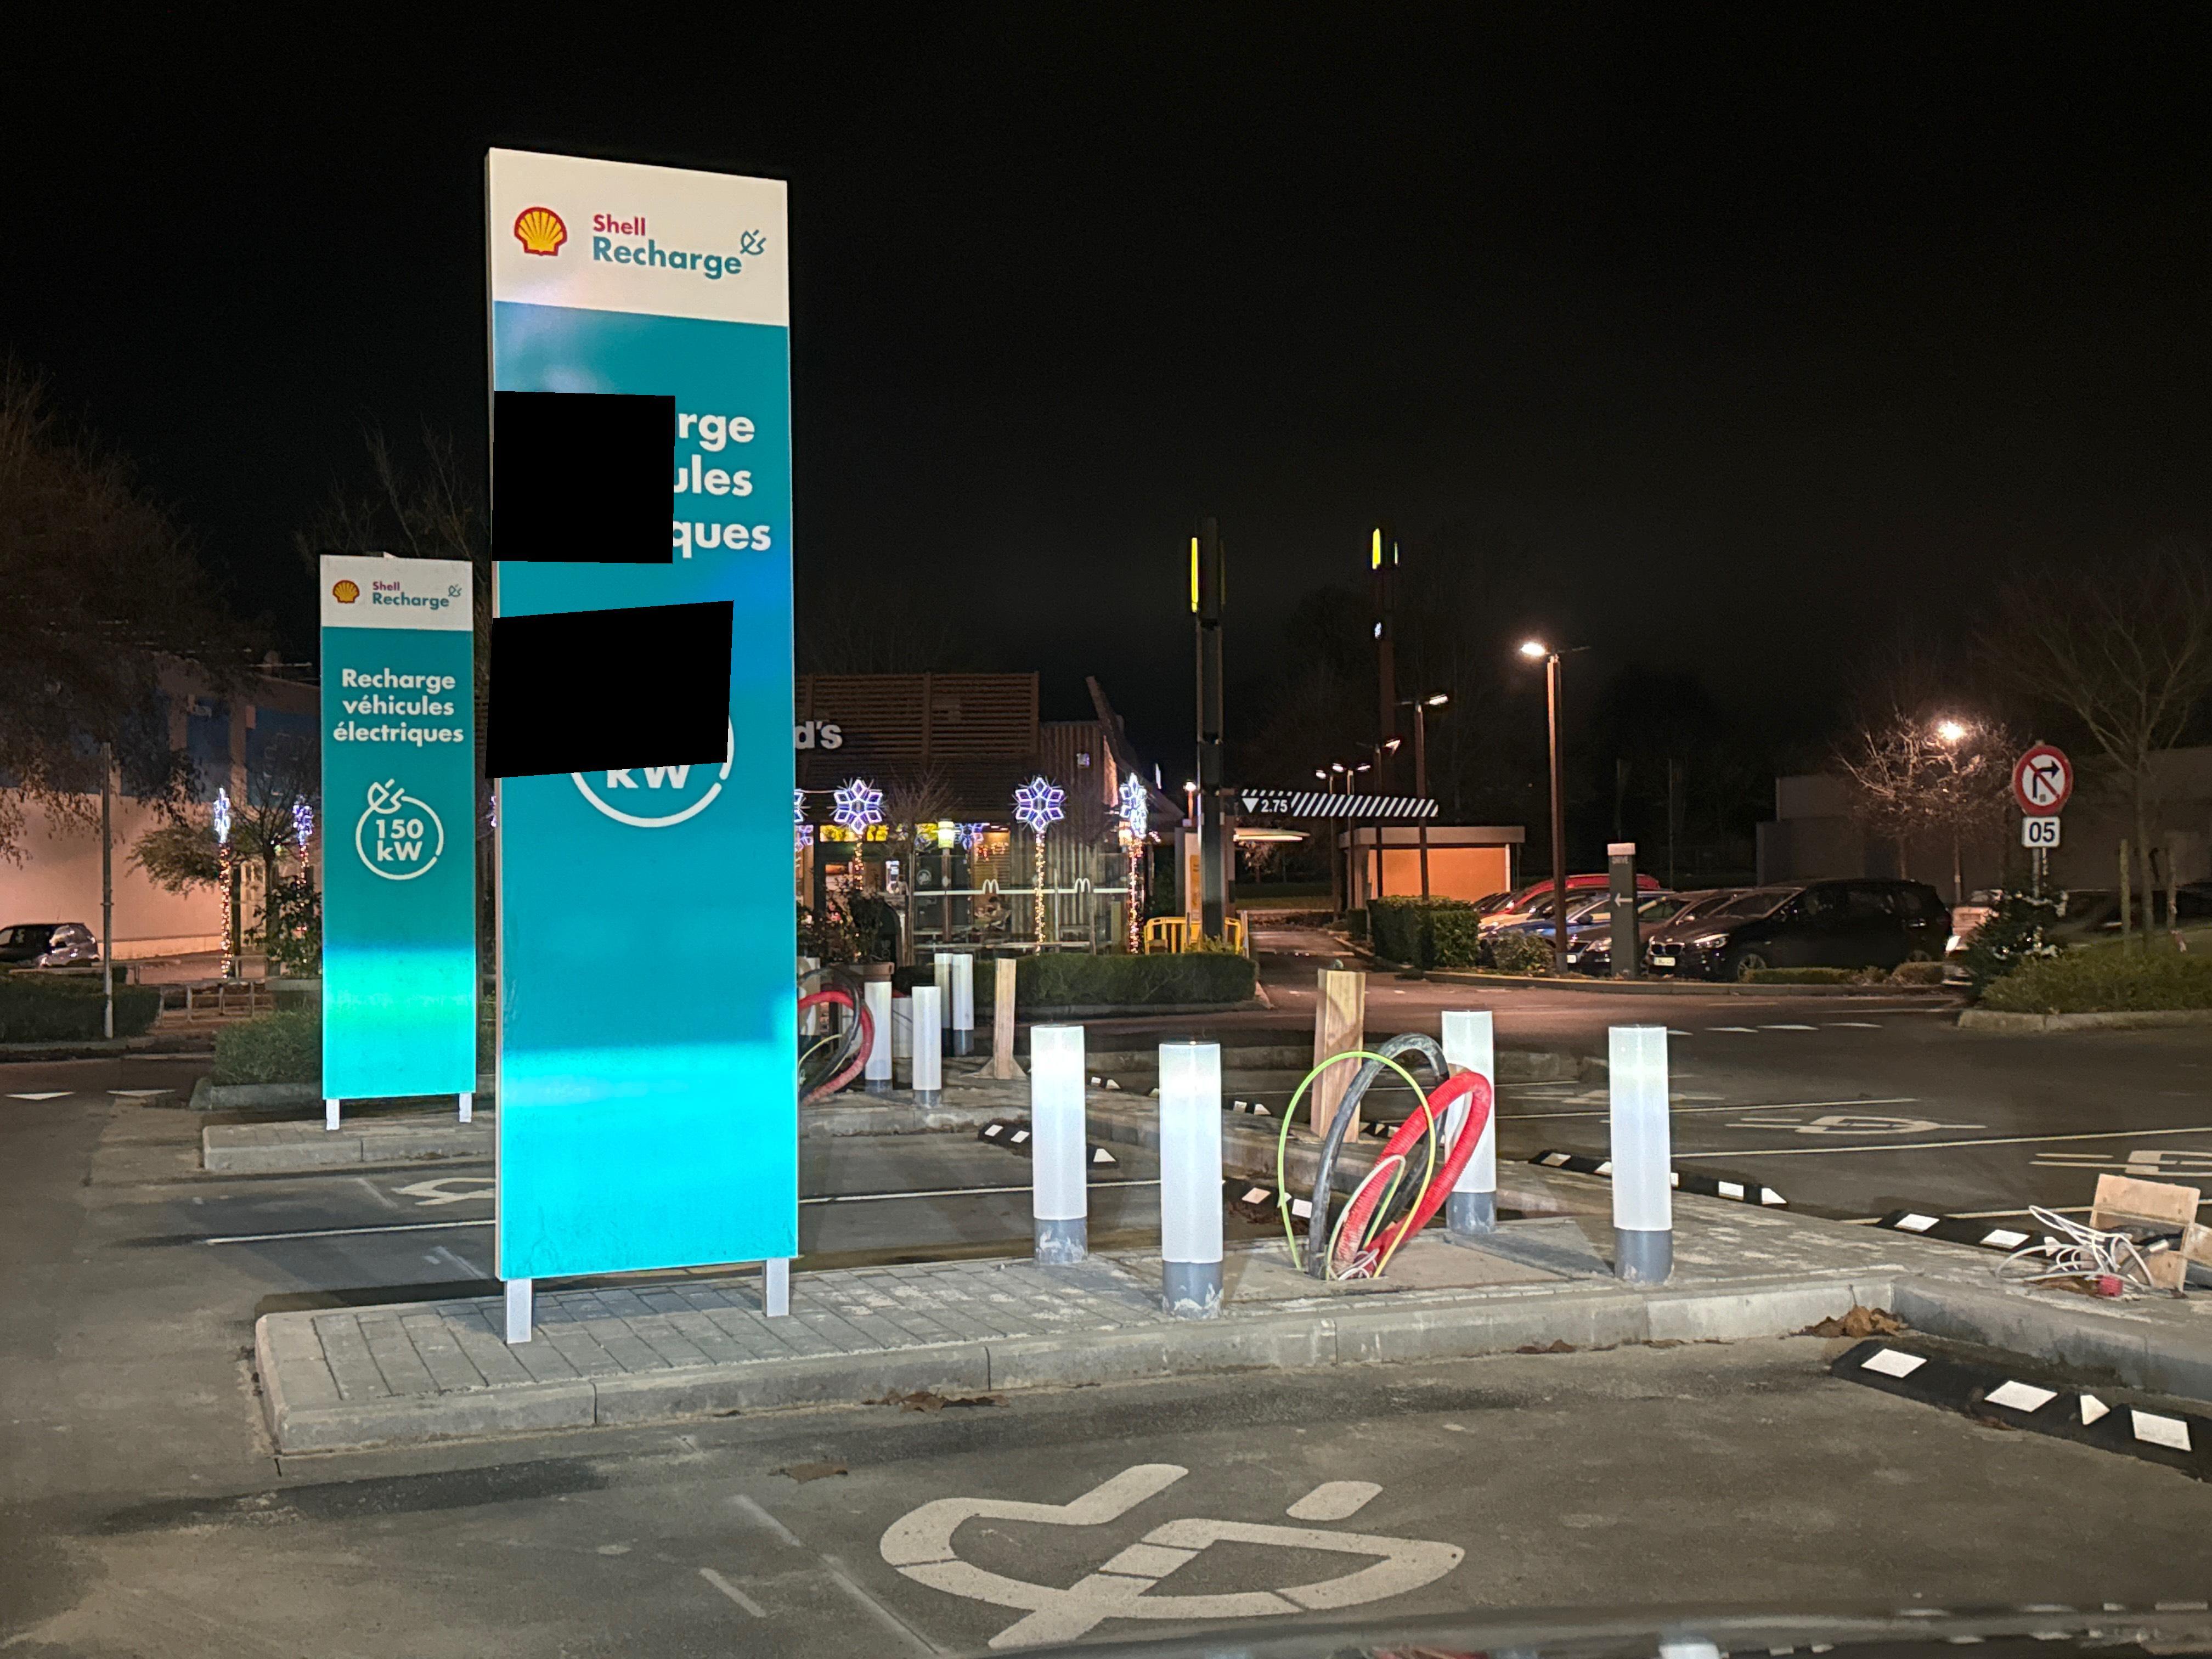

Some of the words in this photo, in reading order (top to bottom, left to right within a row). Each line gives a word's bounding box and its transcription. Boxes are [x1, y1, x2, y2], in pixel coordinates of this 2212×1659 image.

[593, 214, 646, 236] Shell
[593, 236, 742, 279] Recharge
[373, 581, 400, 591] Shell
[373, 592, 450, 610] Recharge
[342, 668, 455, 694] Recharge
[342, 694, 454, 715] véhicules
[333, 721, 464, 747] électriques
[376, 819, 424, 839] 150
[2029, 822, 2055, 843] 05
[377, 840, 422, 861] kW
